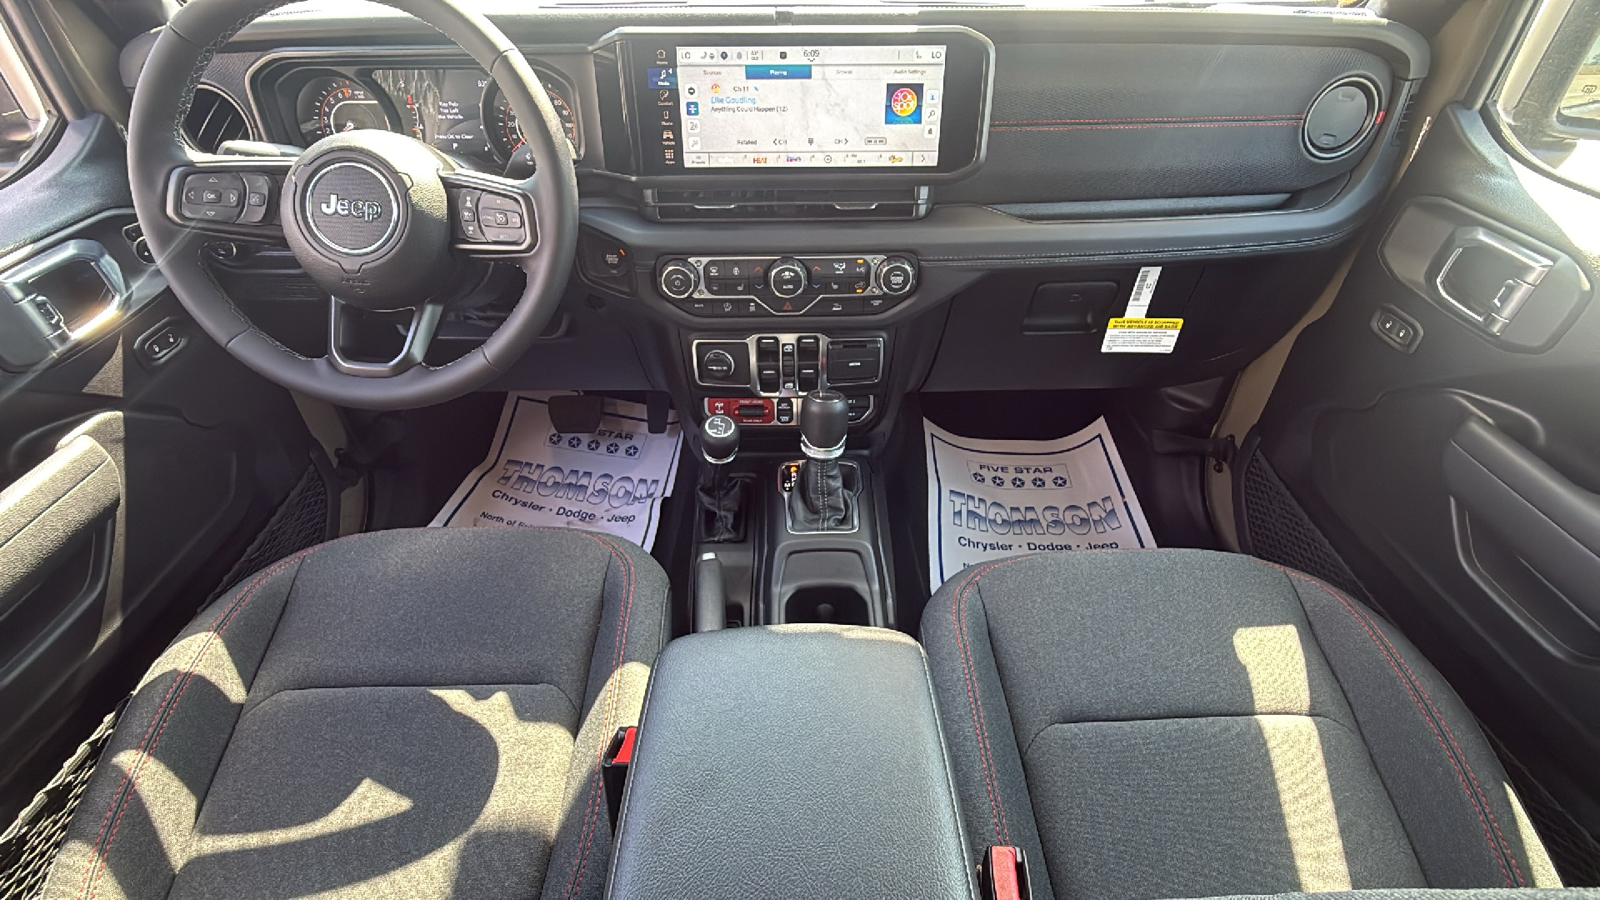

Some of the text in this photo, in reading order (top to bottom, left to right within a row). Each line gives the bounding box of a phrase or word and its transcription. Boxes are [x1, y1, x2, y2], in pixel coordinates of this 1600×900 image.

[803, 49, 819, 57] 6:09
[320, 194, 382, 223] Jeep
[597, 429, 634, 441] STAR
[979, 464, 1053, 474] FIVE STAR
[497, 459, 660, 509] THOMSON
[491, 489, 636, 525] Chrysler Dodge Jeep
[949, 489, 1122, 535] THOMSON
[480, 511, 504, 523] North
[958, 536, 1013, 552] Chrysler
